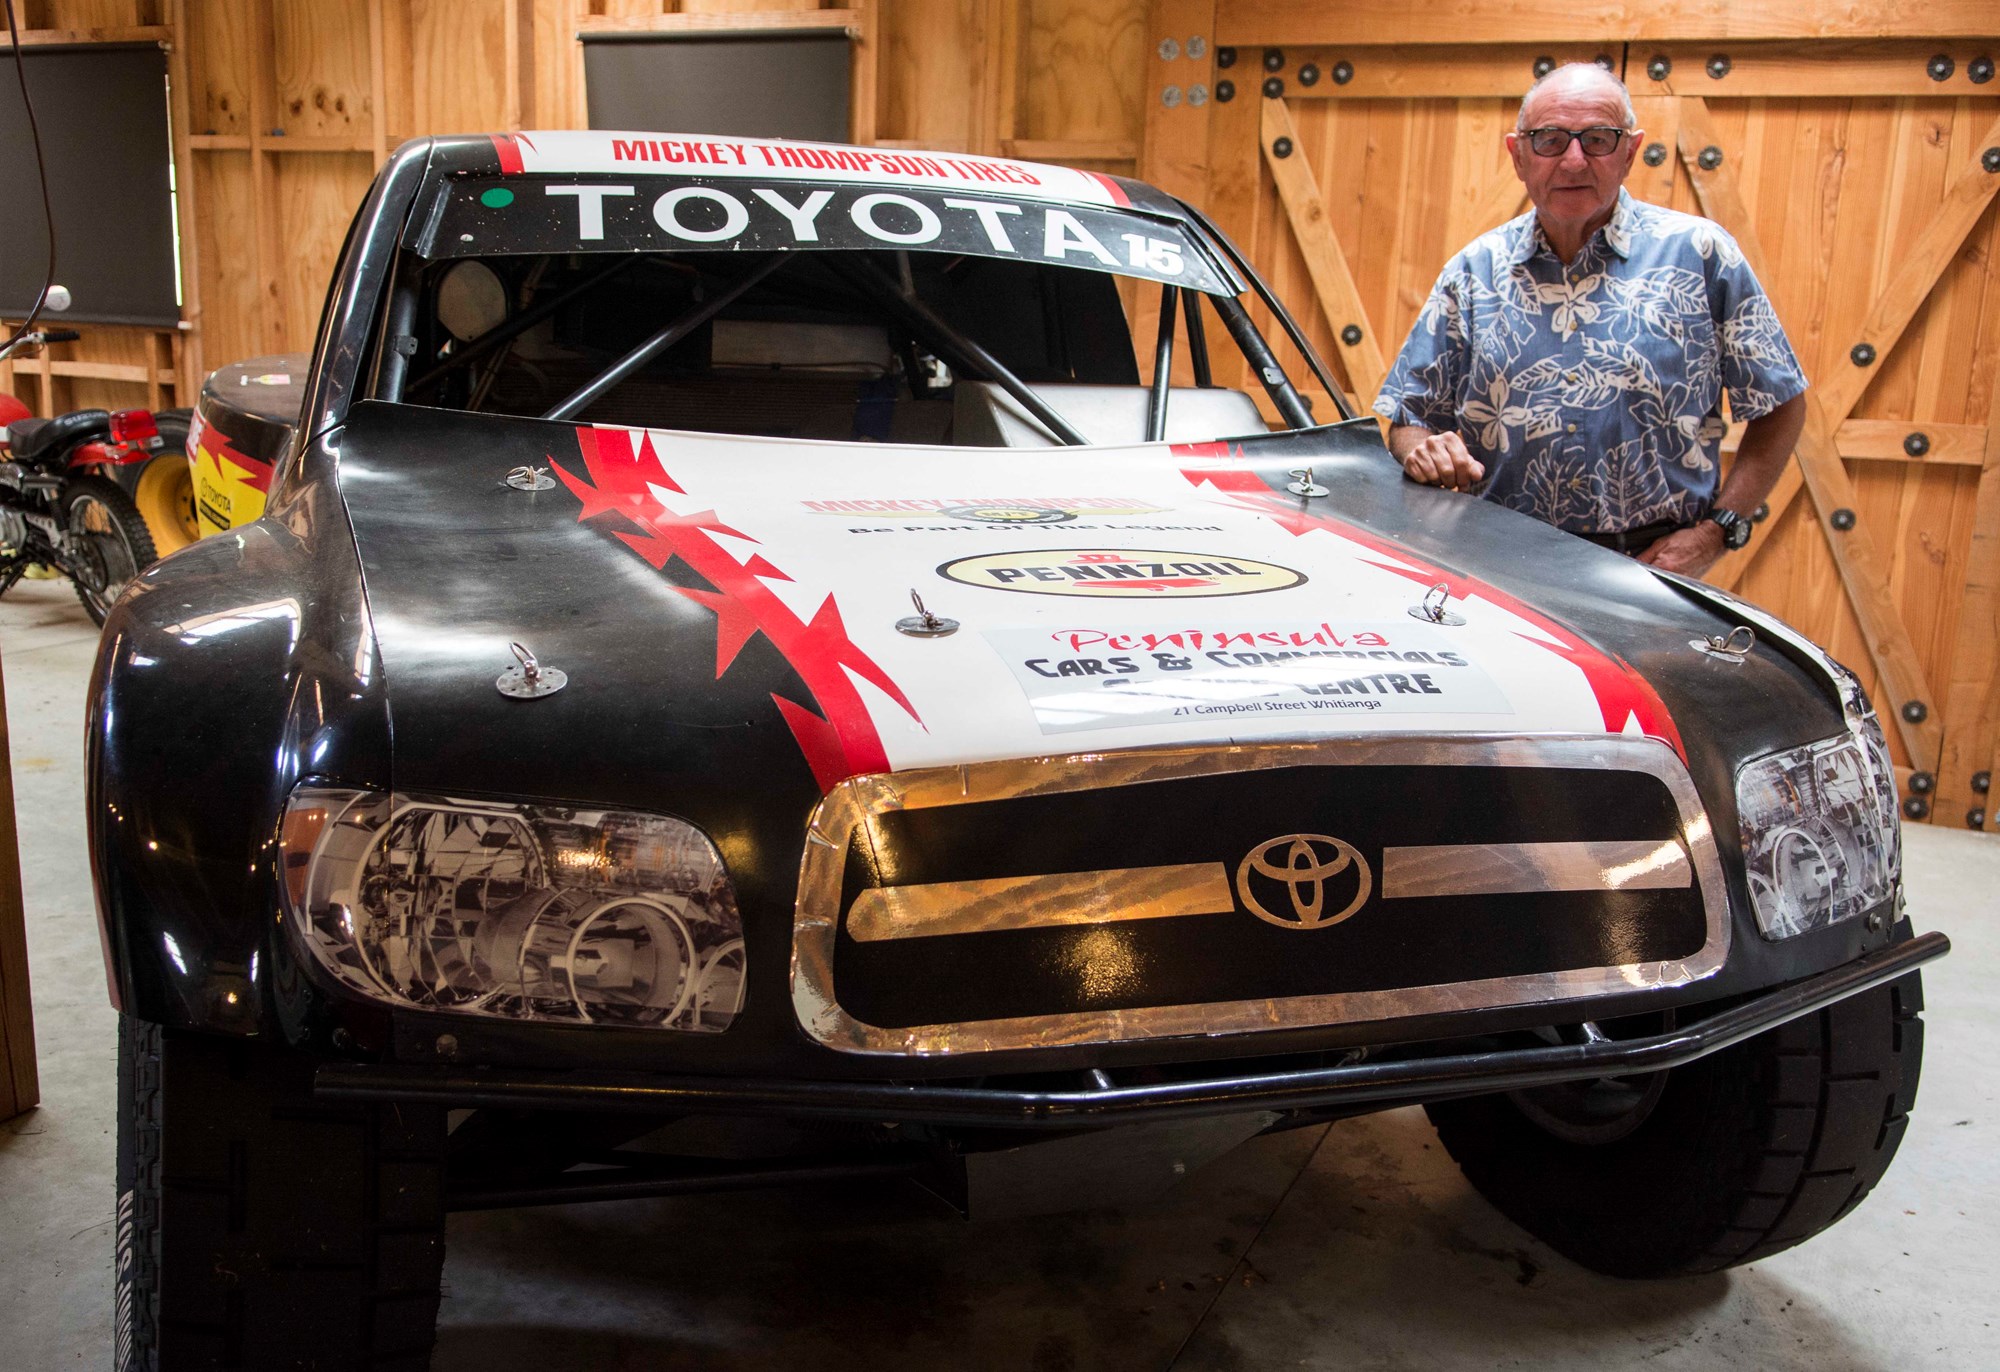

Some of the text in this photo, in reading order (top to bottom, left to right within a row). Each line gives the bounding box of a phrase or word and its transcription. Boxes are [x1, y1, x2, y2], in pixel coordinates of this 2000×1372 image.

[611, 139, 1042, 186] MICKEY THOMPSON TIRES
[545, 185, 1185, 276] TOYOTA 15
[208, 485, 231, 513] TOYOTA
[800, 499, 946, 512] MICKEY
[1106, 524, 1224, 533] Legend
[985, 562, 1262, 583] PENNZOIL
[1051, 622, 1390, 653] Peninsula
[1024, 656, 1140, 678] CARS
[1151, 652, 1193, 671] &
[1173, 699, 1382, 716] 21 Campbell Street Whitianga
